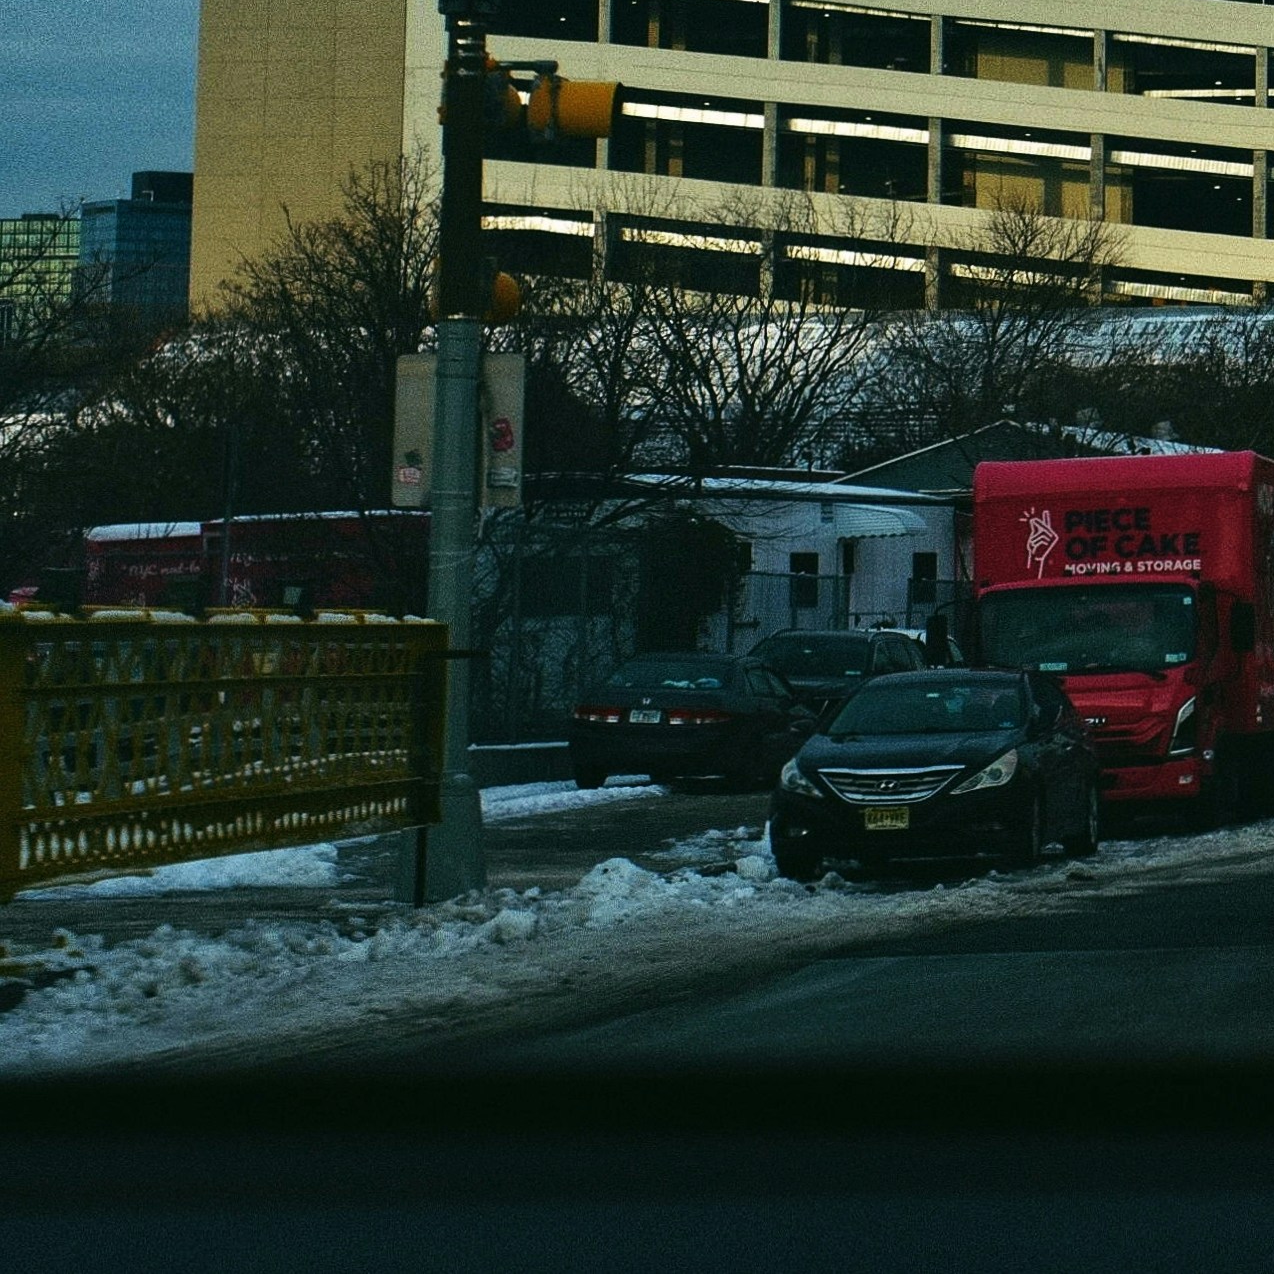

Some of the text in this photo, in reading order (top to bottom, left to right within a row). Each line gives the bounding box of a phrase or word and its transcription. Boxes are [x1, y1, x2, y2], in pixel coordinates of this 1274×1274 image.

[1065, 508, 1150, 532] PIECE
[1065, 533, 1201, 560] OF CAKE
[1064, 559, 1201, 575] MOVING & STORAGE
